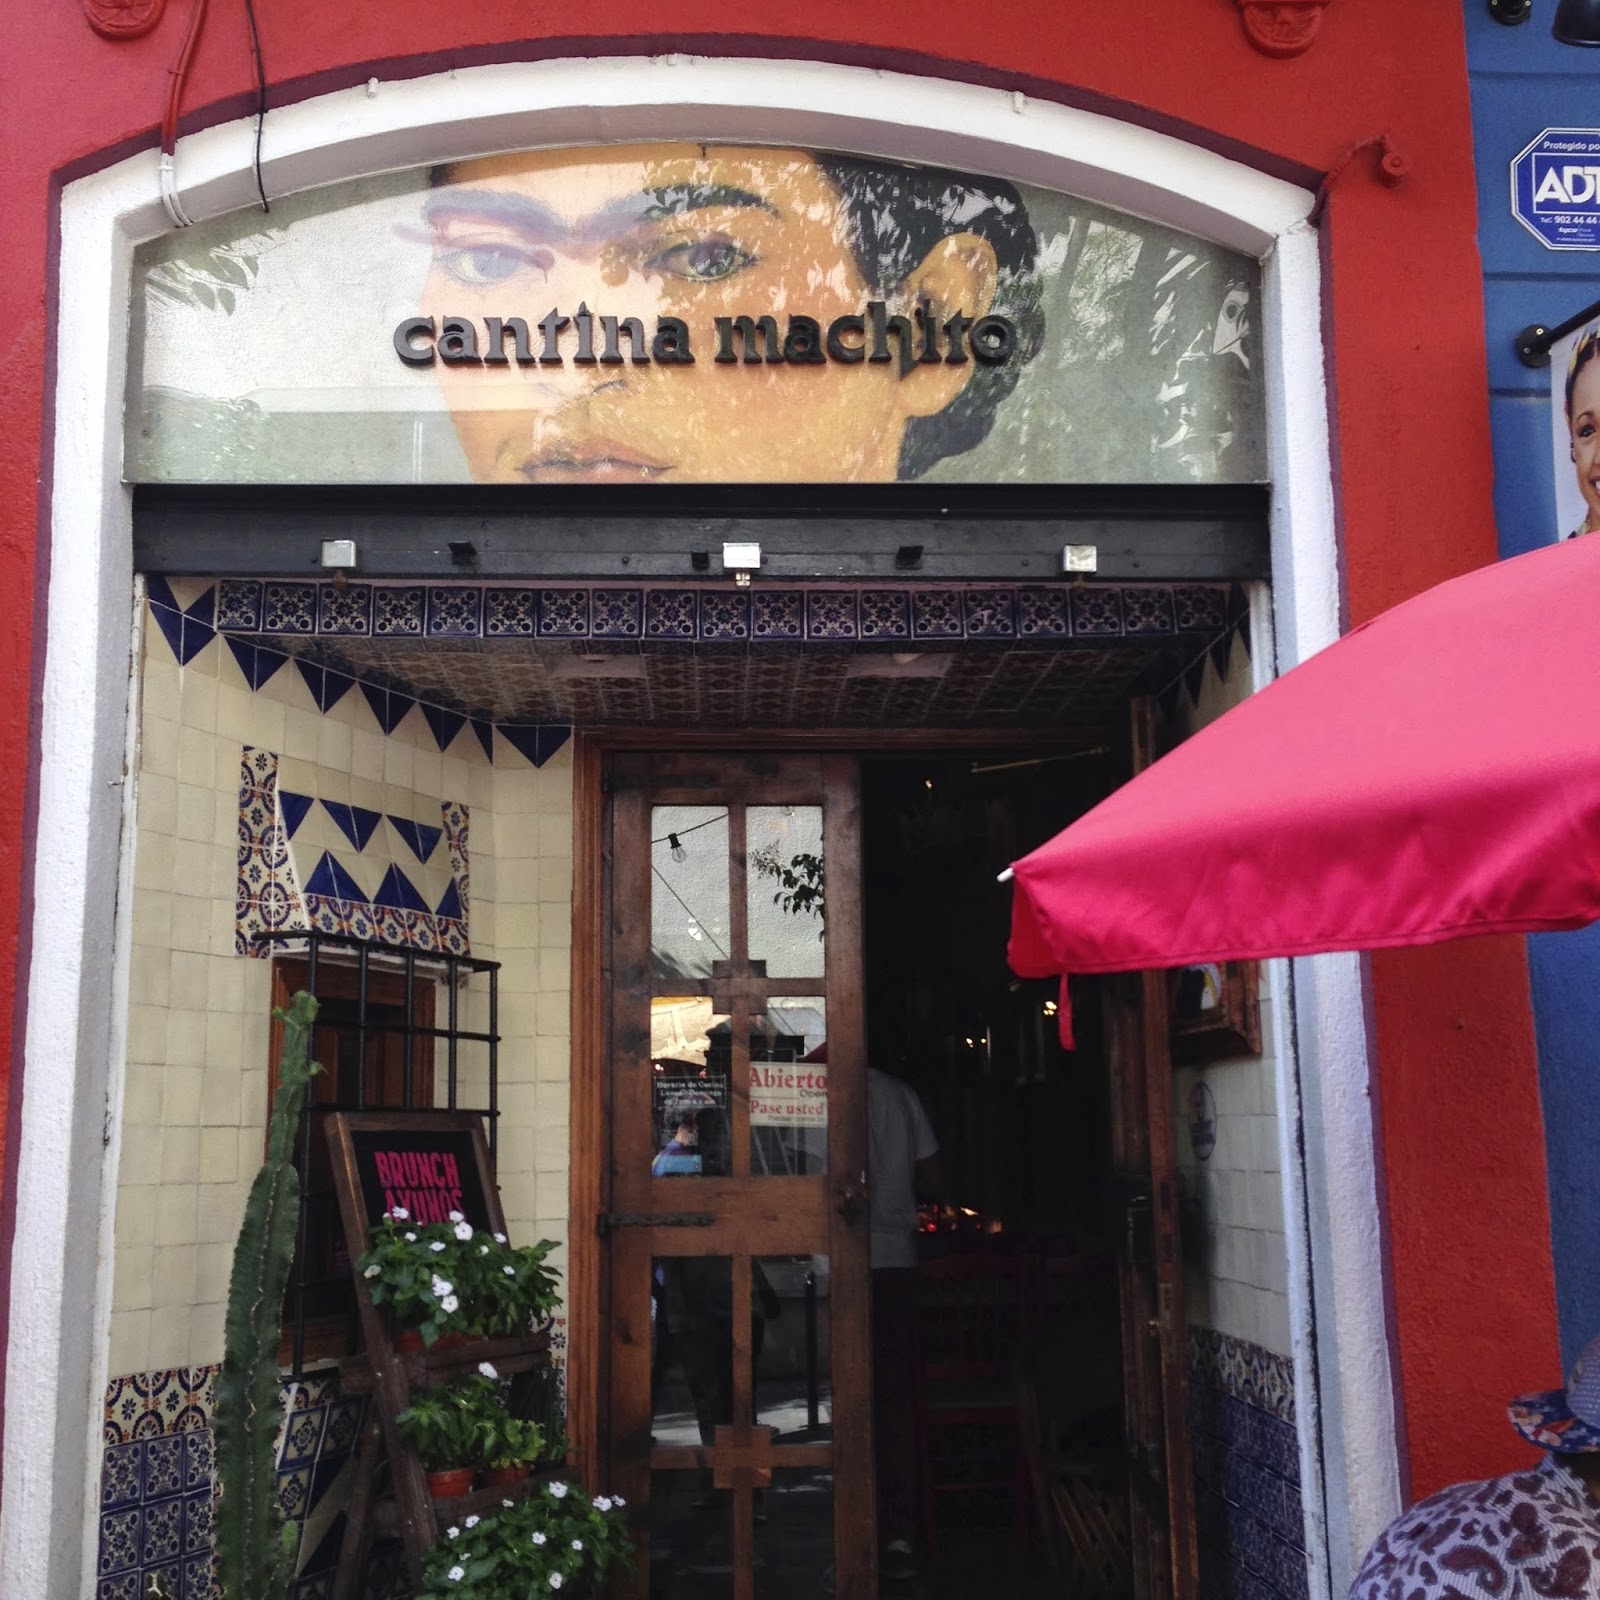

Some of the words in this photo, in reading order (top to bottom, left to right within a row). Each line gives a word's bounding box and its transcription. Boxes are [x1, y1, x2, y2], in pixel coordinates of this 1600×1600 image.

[1543, 140, 1587, 151] Protegido
[1535, 166, 1600, 204] ADT
[1554, 215, 1572, 224] 902
[1573, 216, 1585, 224] 44
[1586, 216, 1597, 224] 44
[392, 300, 696, 365] cantina
[714, 300, 1014, 377] machito
[750, 1066, 828, 1089] Abierto
[750, 1100, 782, 1114] Pase
[786, 1102, 824, 1115] usted
[374, 1151, 461, 1189] BRUNCH
